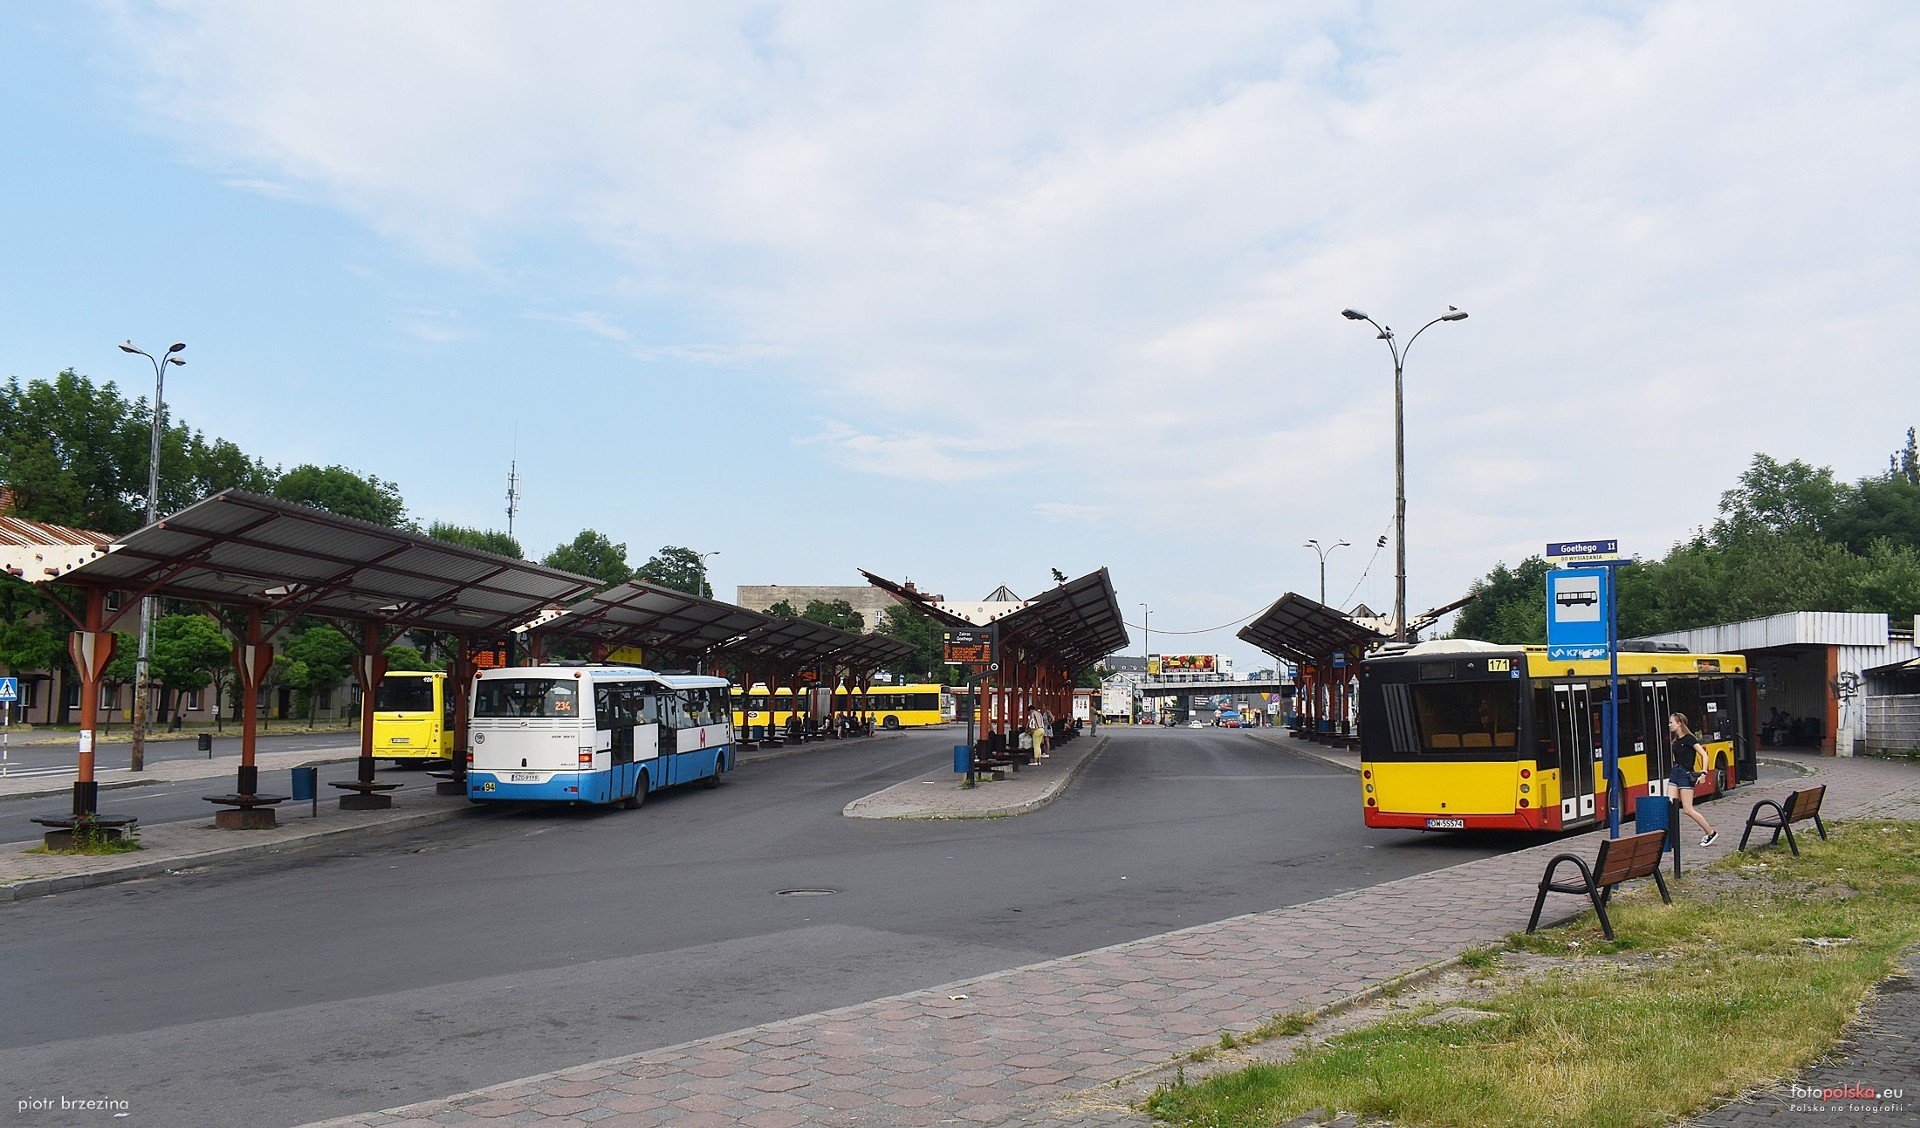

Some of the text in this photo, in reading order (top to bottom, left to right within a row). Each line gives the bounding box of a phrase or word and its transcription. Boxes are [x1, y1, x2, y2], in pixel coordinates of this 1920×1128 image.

[1561, 542, 1616, 553] Goethego 11
[1489, 660, 1508, 670] 171
[555, 701, 571, 711] 234
[485, 783, 495, 791] 94
